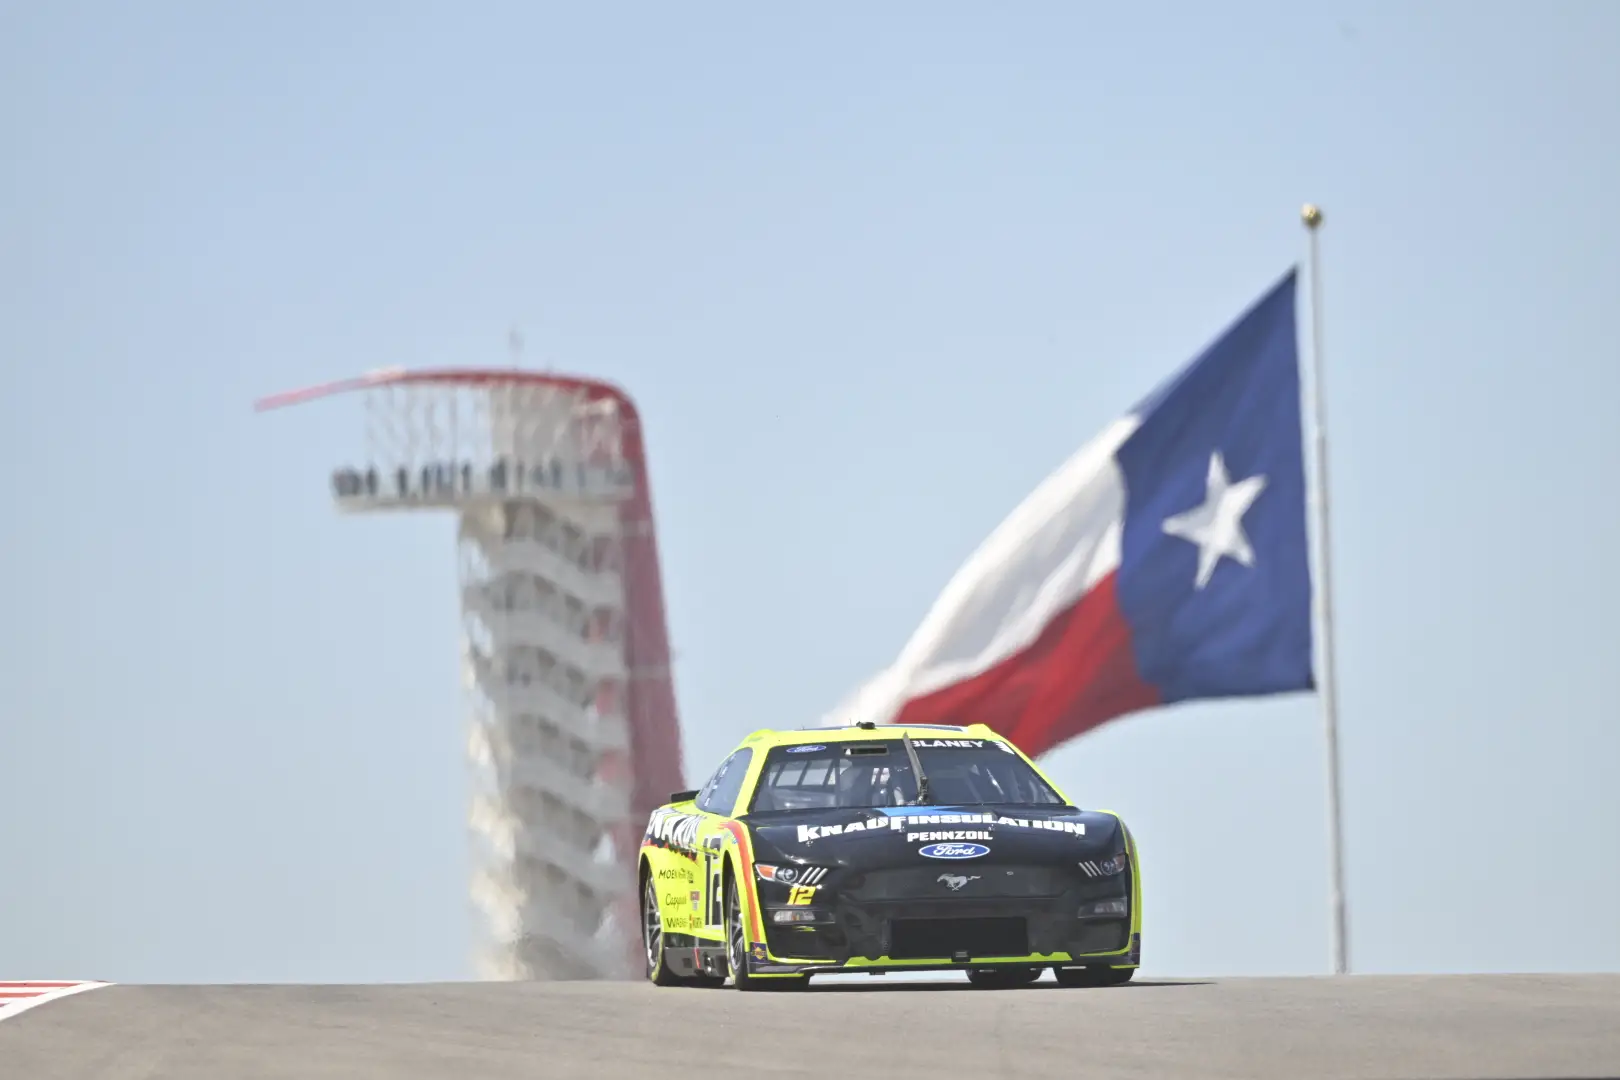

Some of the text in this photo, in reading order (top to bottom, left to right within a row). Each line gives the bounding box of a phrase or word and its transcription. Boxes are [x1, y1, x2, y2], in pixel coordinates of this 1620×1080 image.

[907, 830, 993, 842] PENNZOIL
[933, 844, 975, 857] Ford
[786, 886, 816, 905] 12
